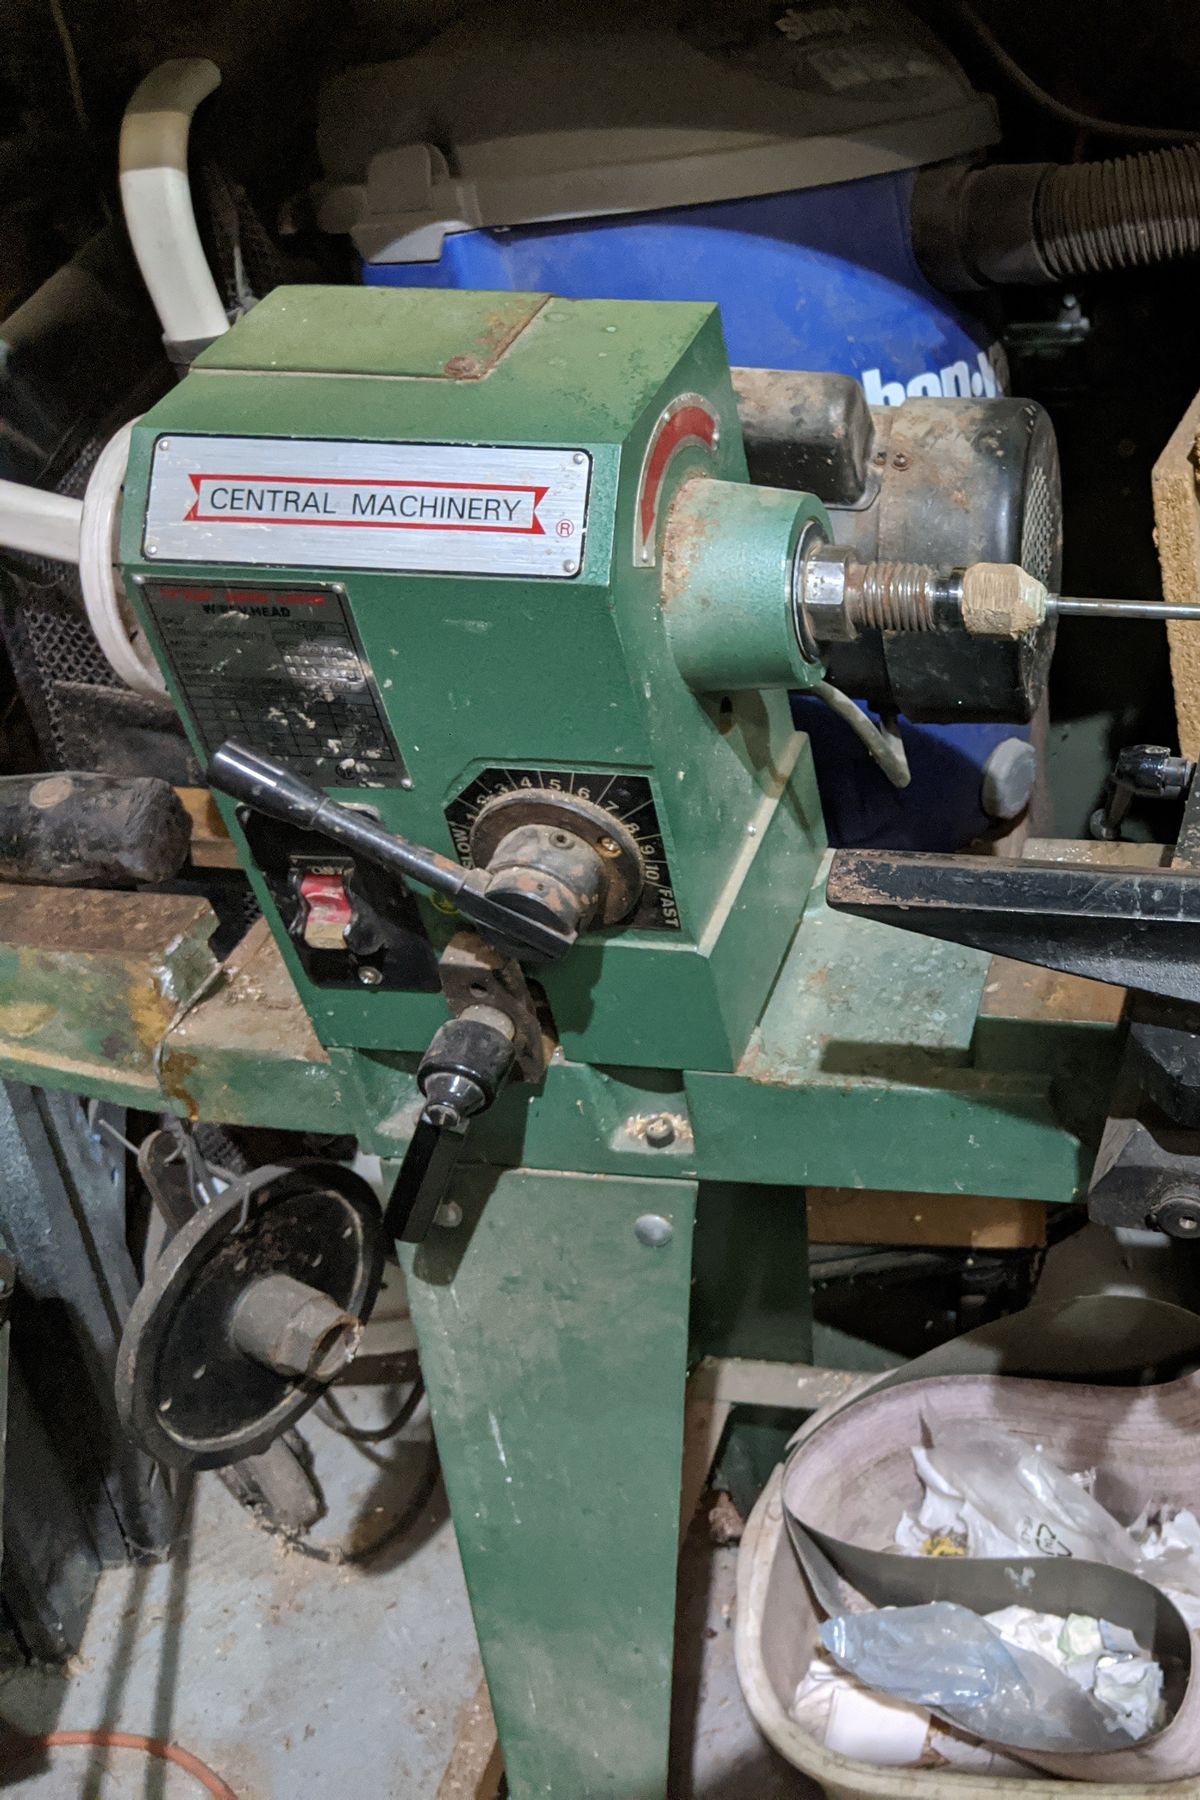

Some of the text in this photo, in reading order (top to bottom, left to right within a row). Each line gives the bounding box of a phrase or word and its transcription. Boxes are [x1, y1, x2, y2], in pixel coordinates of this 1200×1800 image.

[209, 487, 522, 521] CENTRAL MACHINERY
[520, 776, 533, 788] 4
[549, 778, 562, 791] 5
[577, 787, 591, 799] 6
[605, 800, 619, 812] 7
[625, 822, 640, 835] 8
[641, 844, 655, 856] 9
[659, 888, 680, 928] FAST
